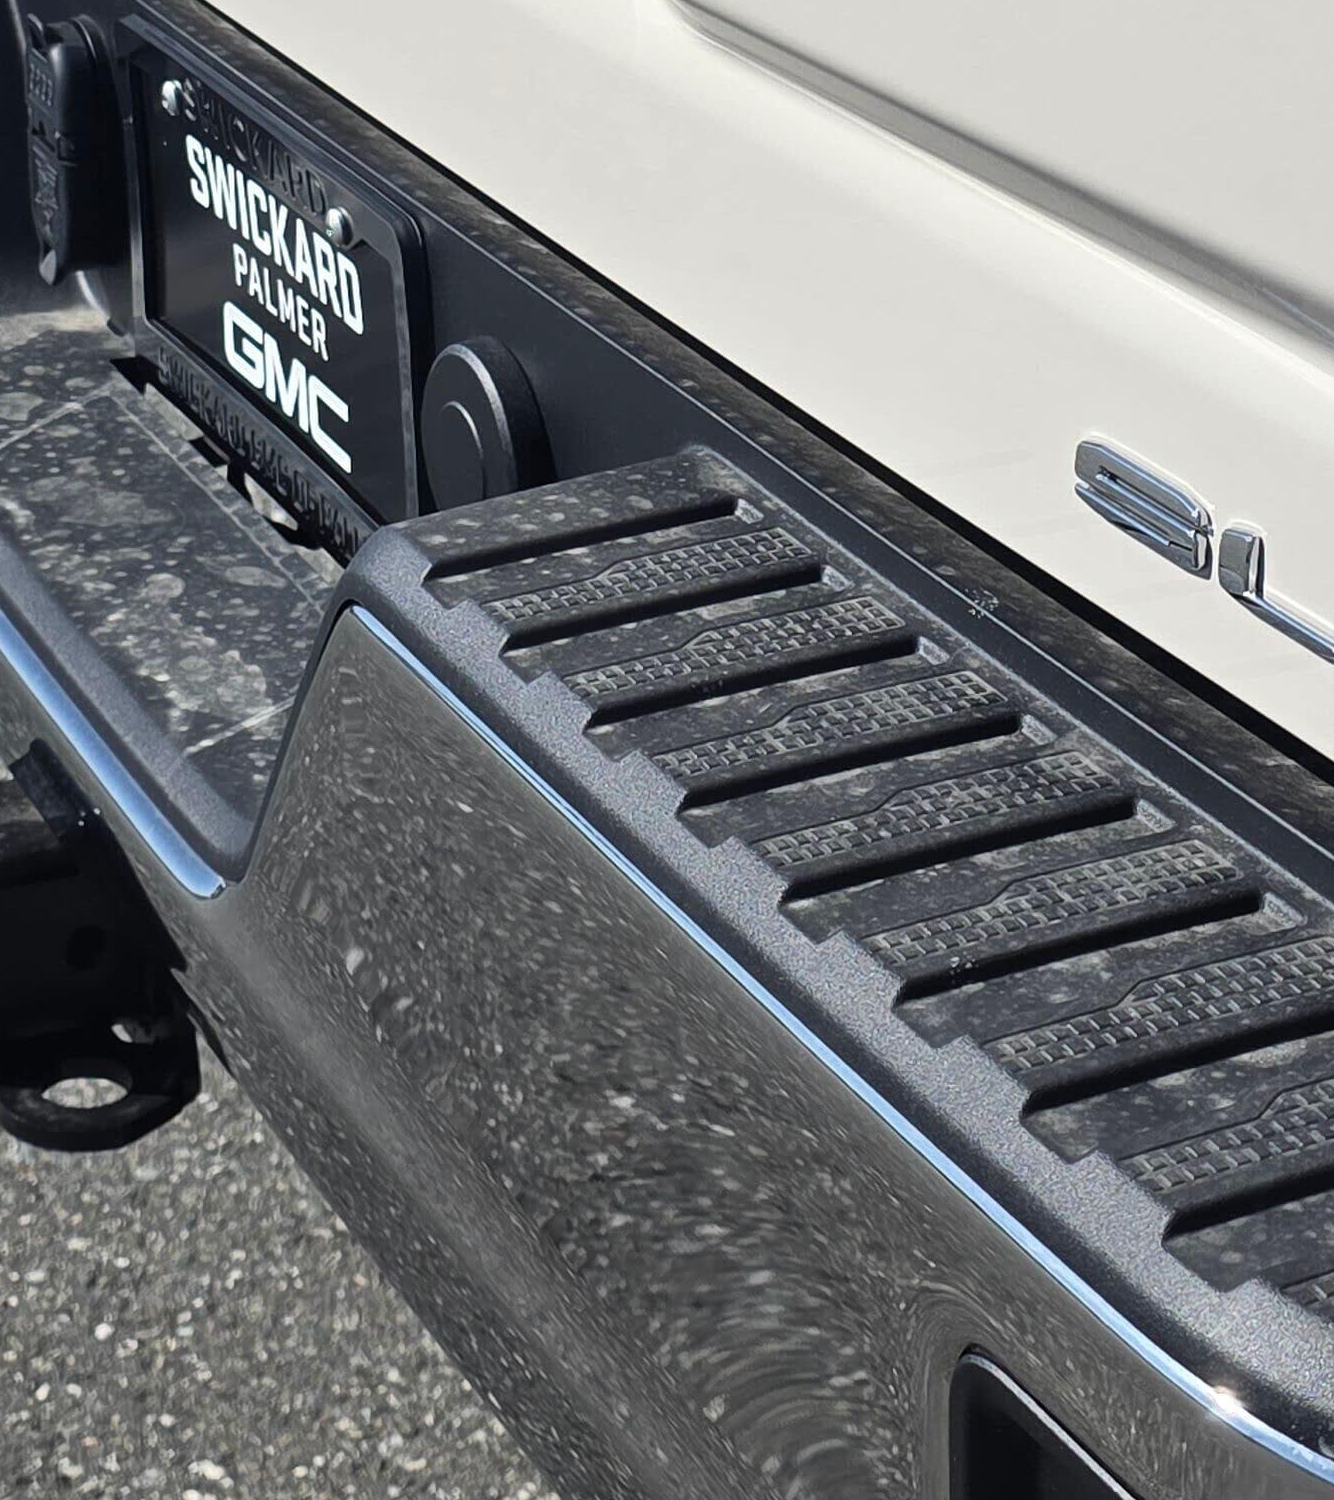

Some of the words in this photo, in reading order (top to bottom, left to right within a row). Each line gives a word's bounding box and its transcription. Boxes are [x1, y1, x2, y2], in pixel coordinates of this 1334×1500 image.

[181, 77, 328, 216] SWICKARD
[185, 133, 365, 335] SWICKARD
[232, 243, 330, 361] PALMER
[222, 300, 353, 474] GMC
